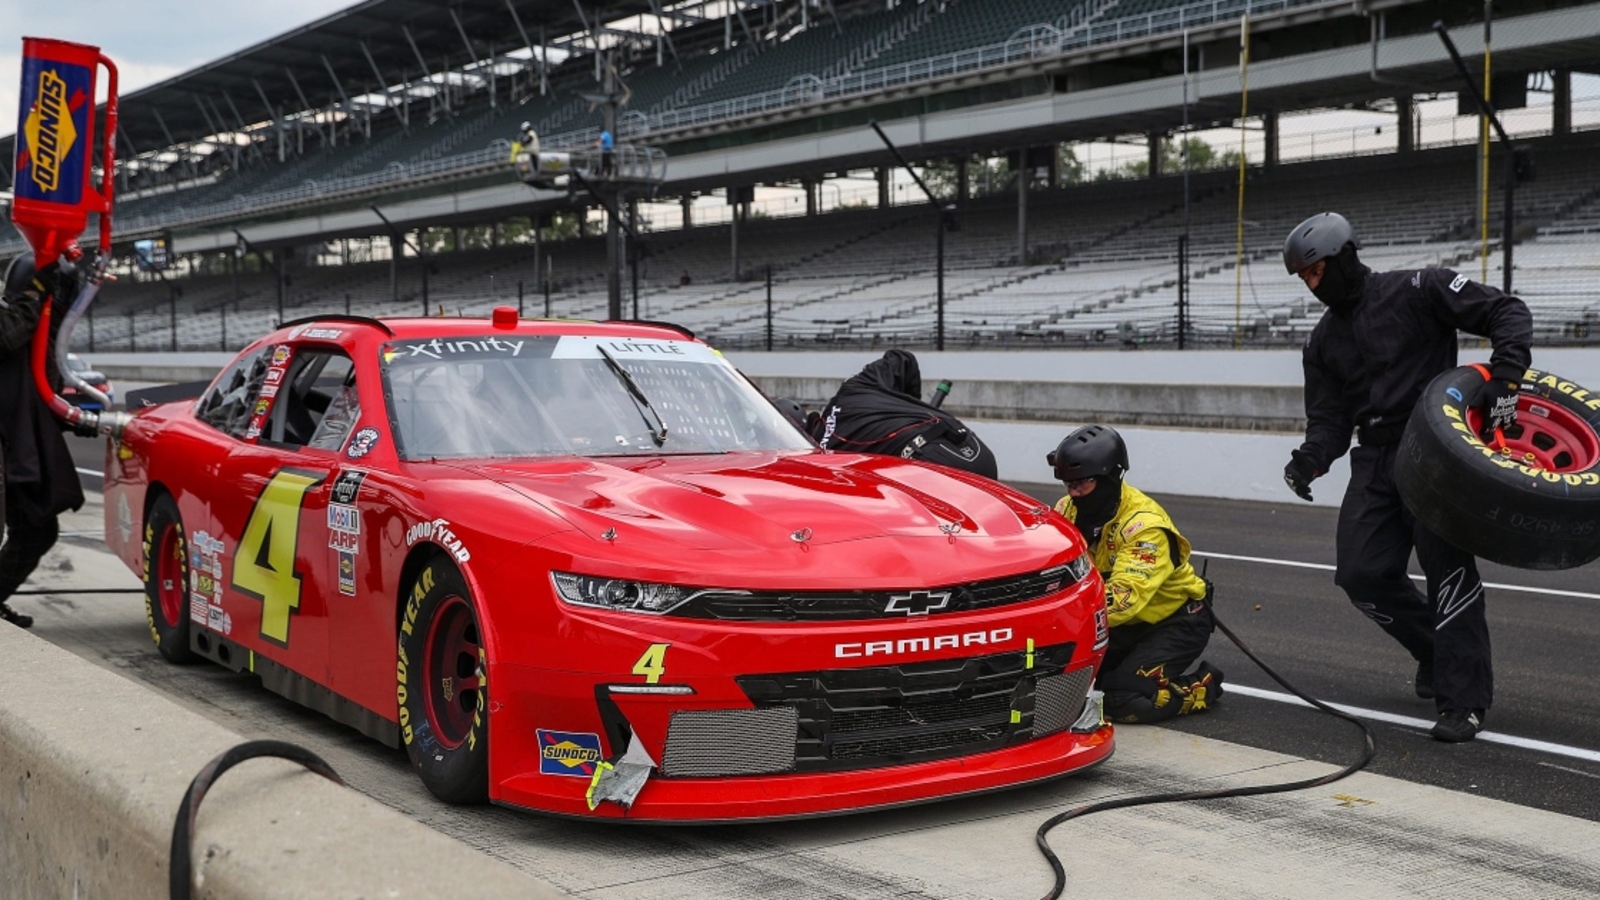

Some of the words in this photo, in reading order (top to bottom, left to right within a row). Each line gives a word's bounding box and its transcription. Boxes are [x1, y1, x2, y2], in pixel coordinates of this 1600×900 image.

[35, 75, 62, 187] SUNOCO
[406, 336, 525, 359] xfinity
[609, 342, 685, 355] LITTLE
[1523, 369, 1600, 411] EAGLE
[1442, 404, 1600, 486] GOODYEAR
[329, 506, 350, 527] Mobil
[351, 510, 358, 528] 1
[232, 471, 322, 643] 4
[330, 530, 357, 549] ARP
[406, 520, 471, 564] GOODYEAR
[397, 566, 435, 746] GOODYEAR
[834, 628, 1013, 658] CAMARO
[632, 644, 671, 684] 4
[545, 746, 597, 761] SUNOCO
